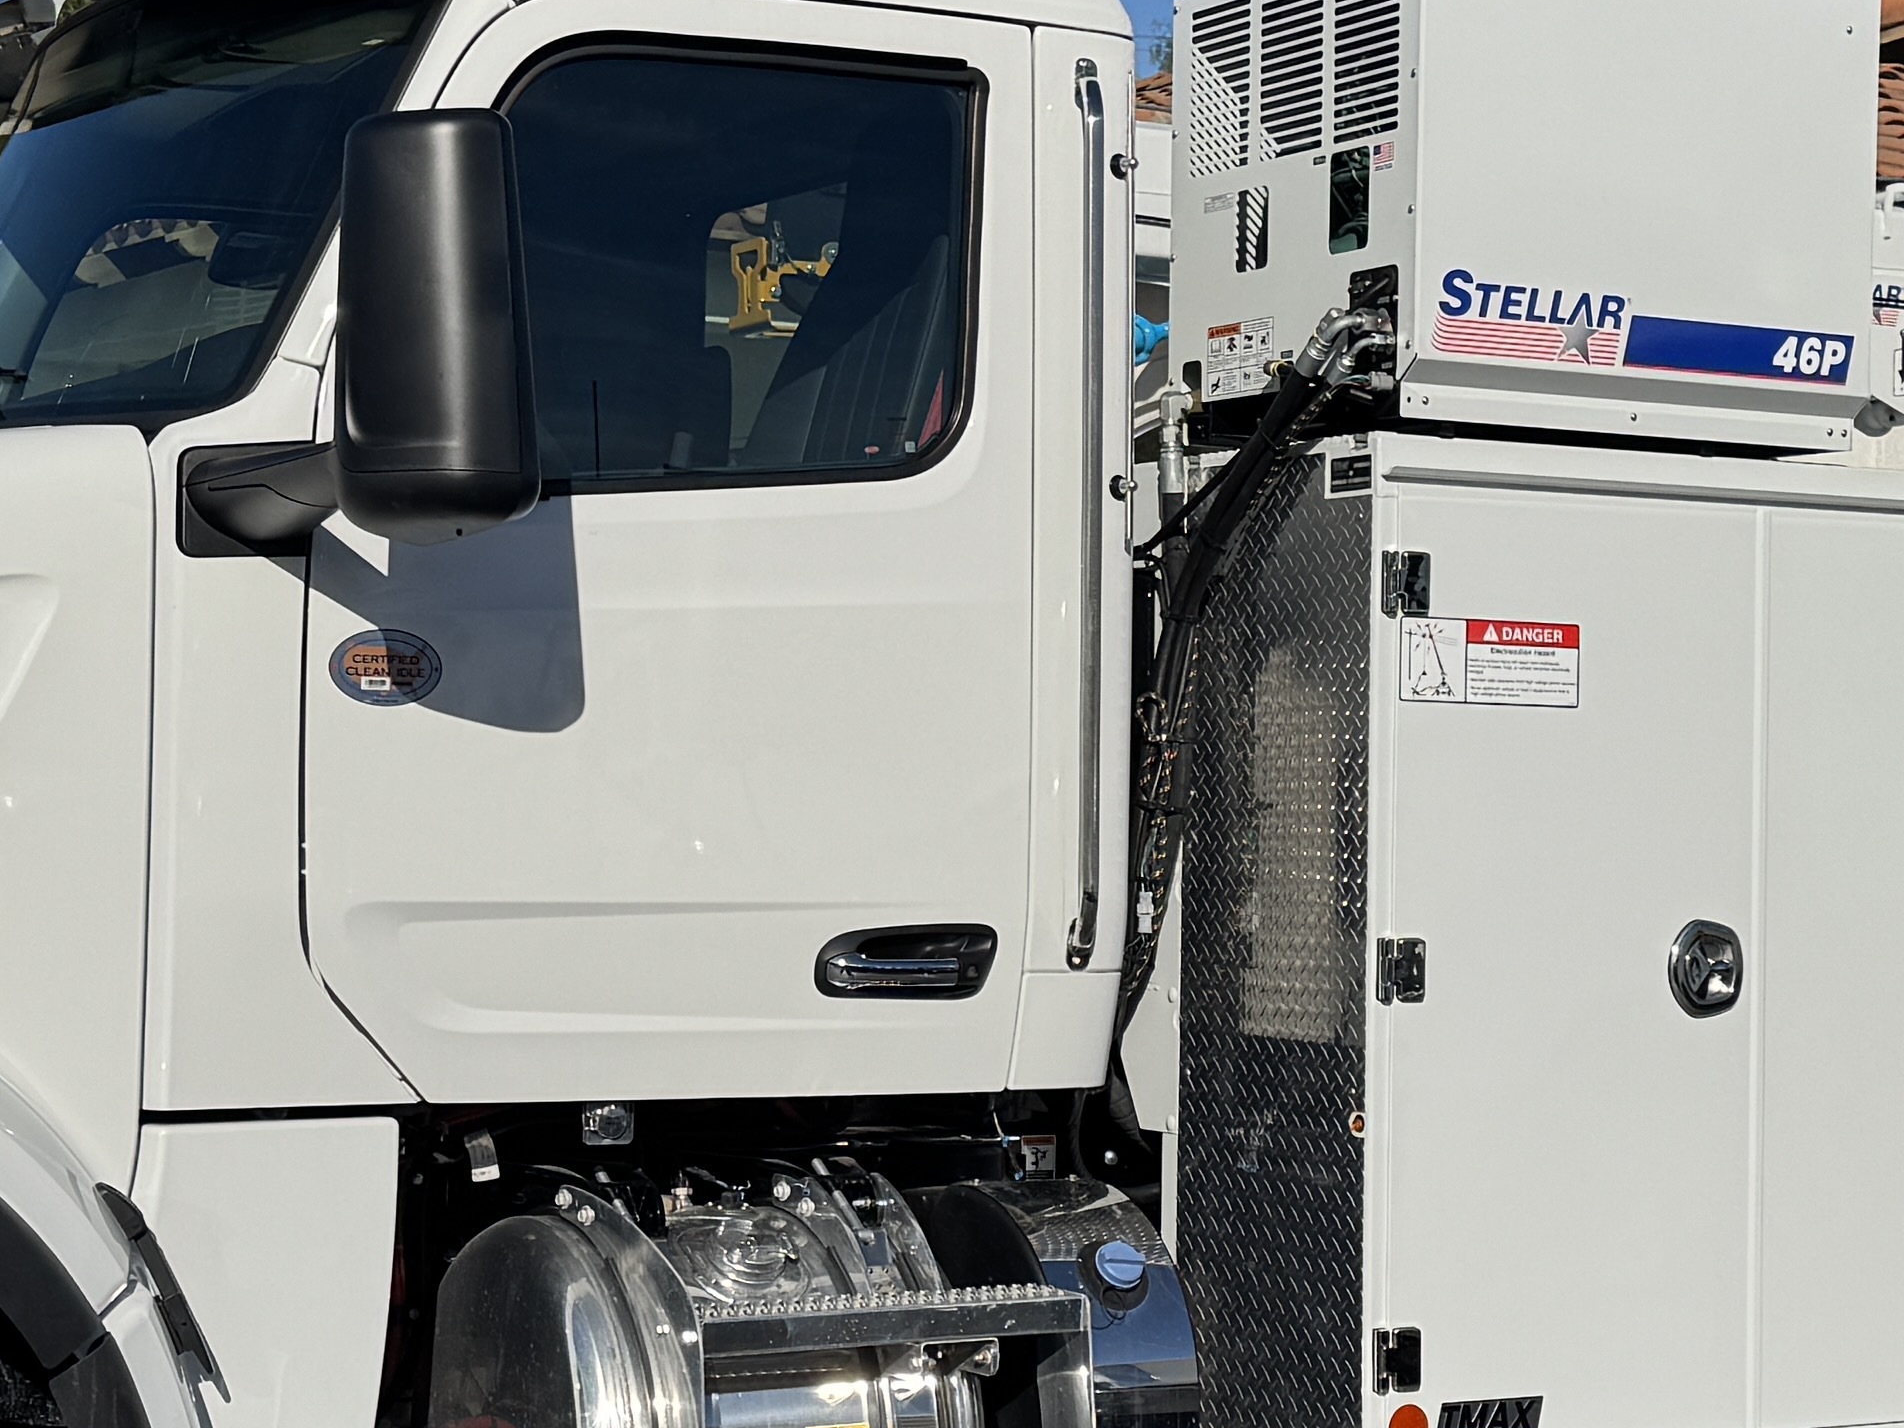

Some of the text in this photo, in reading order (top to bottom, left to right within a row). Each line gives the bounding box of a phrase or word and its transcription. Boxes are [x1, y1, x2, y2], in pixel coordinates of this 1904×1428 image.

[1439, 269, 1625, 329] STELLAR
[1772, 336, 1847, 376] 46P
[1502, 626, 1563, 643] DANGER
[352, 654, 420, 665] CERTIFIED
[345, 666, 425, 678] CLEAN IDLE
